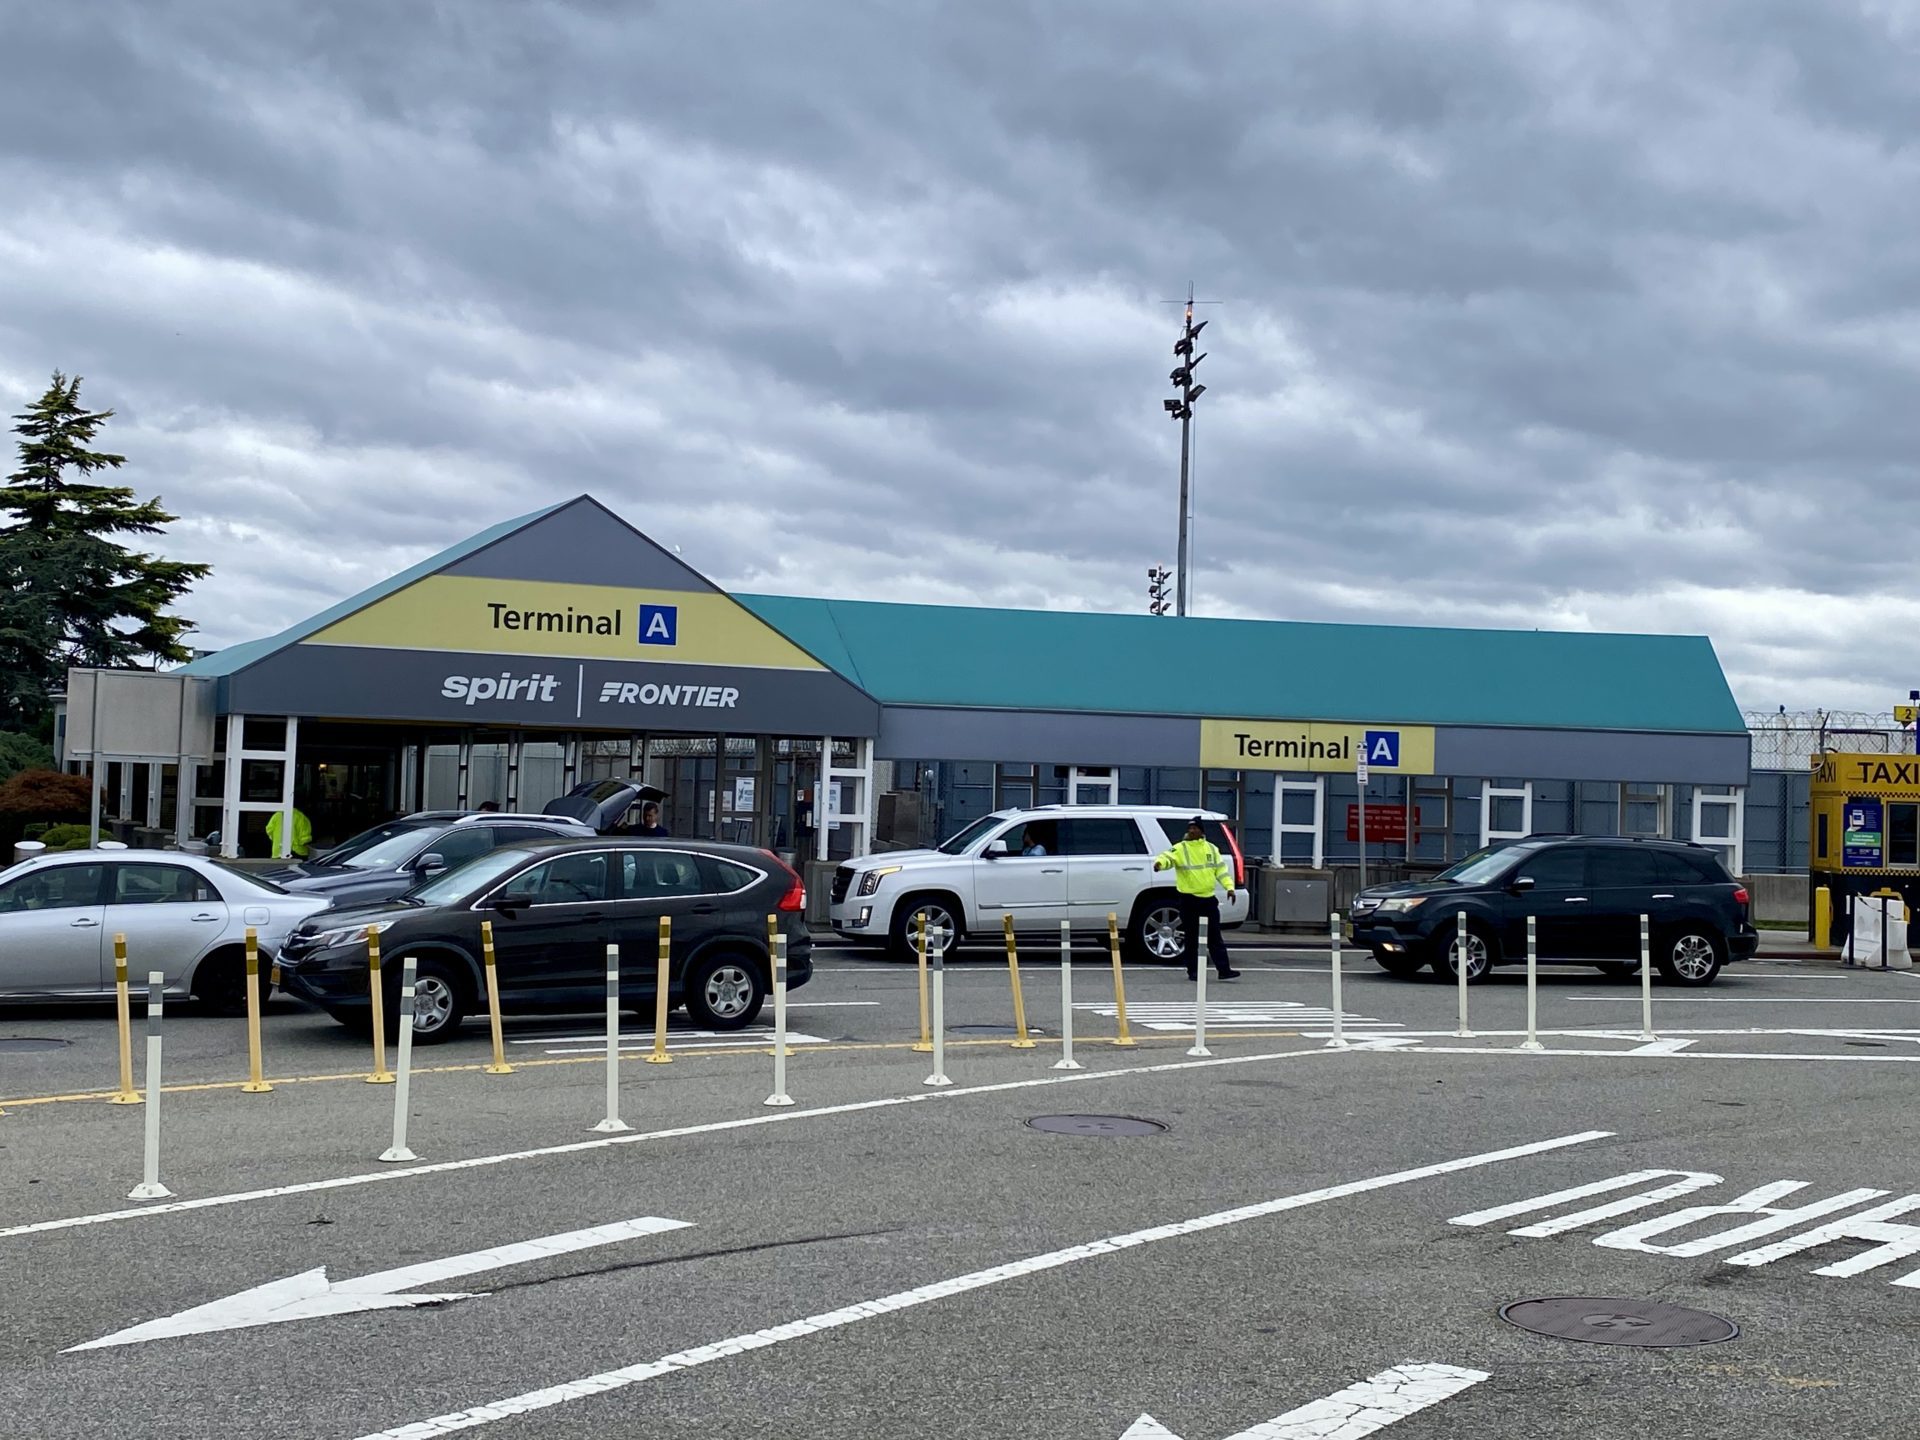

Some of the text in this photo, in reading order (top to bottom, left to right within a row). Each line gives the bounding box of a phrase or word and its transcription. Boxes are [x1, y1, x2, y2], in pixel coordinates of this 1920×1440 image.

[487, 603, 670, 639] Terminal A
[441, 672, 739, 708] spirit FRONTIER
[1905, 708, 1912, 720] 2
[1234, 734, 1393, 761] Terminal A
[1857, 762, 1920, 785] TAXI
[1447, 1169, 1920, 1290] HRU
